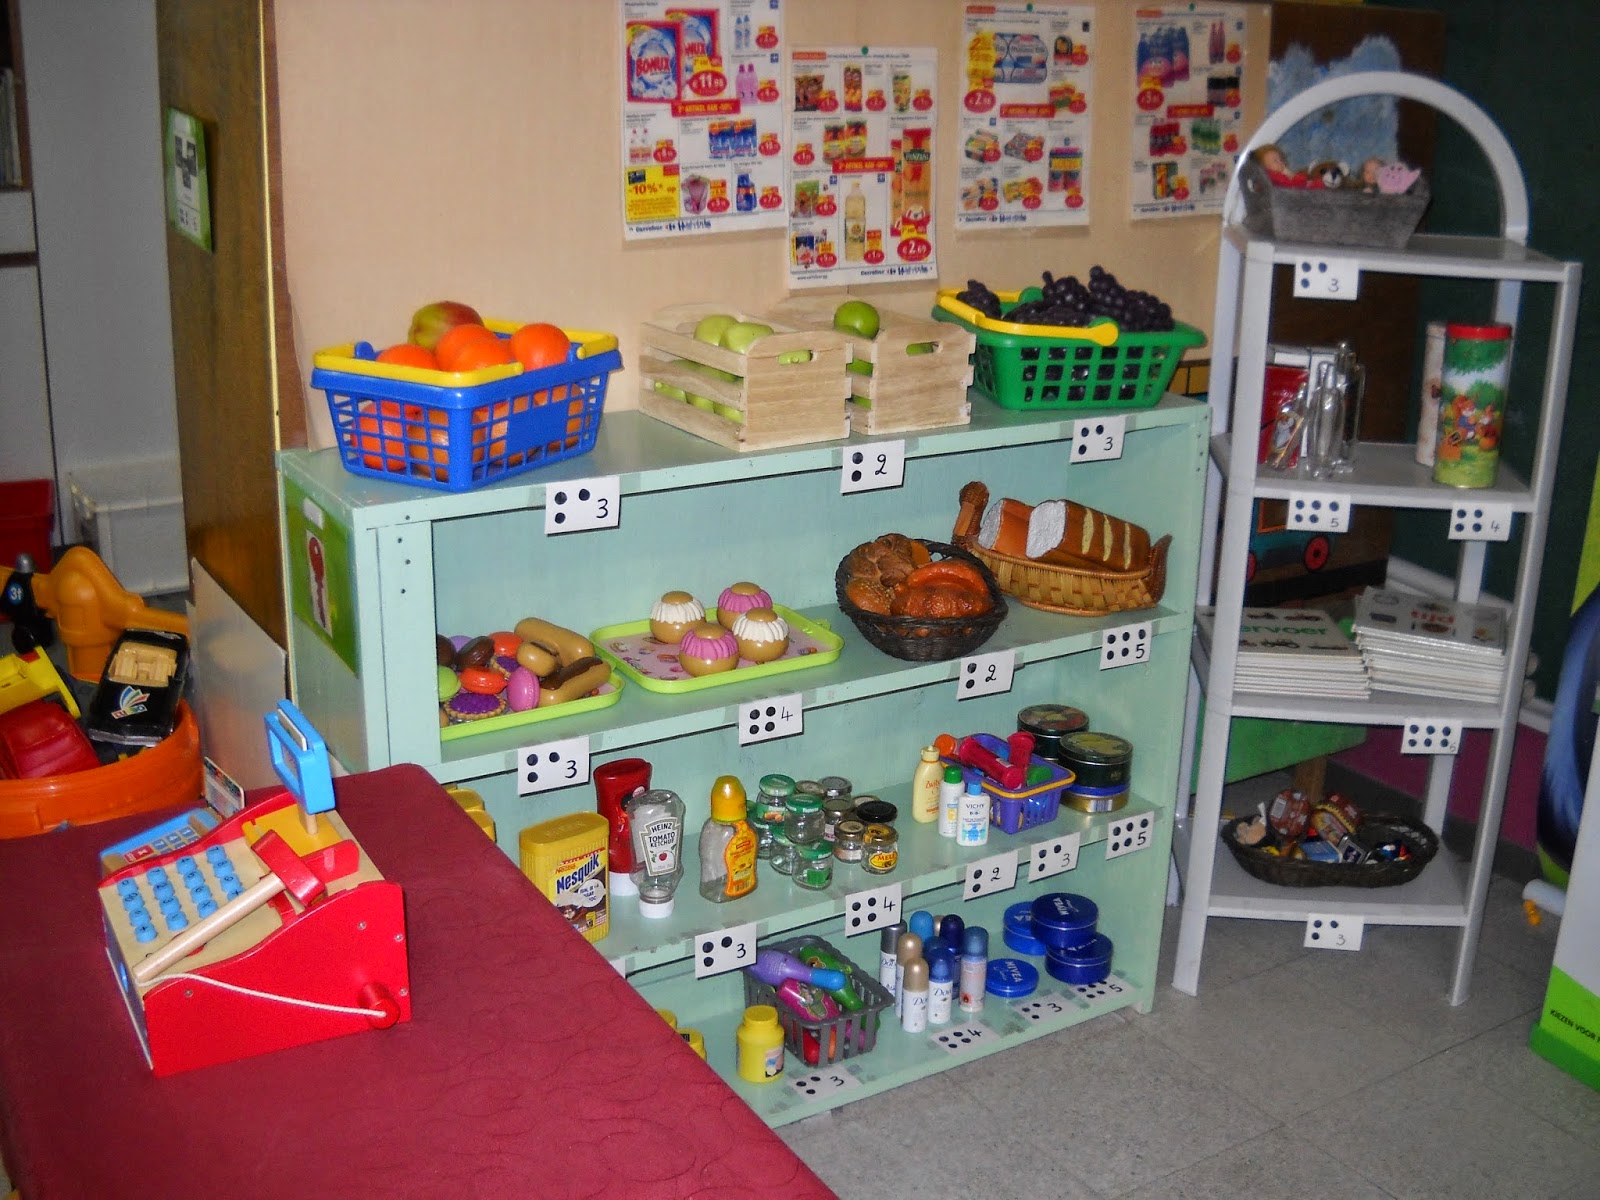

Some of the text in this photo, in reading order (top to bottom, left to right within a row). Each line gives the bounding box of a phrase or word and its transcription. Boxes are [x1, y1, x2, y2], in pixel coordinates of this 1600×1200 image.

[636, 56, 671, 76] BONUX
[1327, 278, 1340, 293] 3
[1103, 437, 1114, 452] 3
[874, 453, 888, 476] 2
[596, 498, 609, 519] 3
[1330, 517, 1340, 528] 5
[1490, 521, 1501, 532] 4
[1134, 643, 1146, 660] 5
[984, 664, 997, 683] 2
[781, 706, 794, 722] 4
[564, 760, 578, 779] 3
[651, 822, 673, 833] HEINZ
[649, 831, 676, 843] TOMATO
[650, 838, 675, 848] KETCHUP
[1136, 831, 1147, 846] 5
[1061, 853, 1071, 868] 3
[556, 853, 600, 895] Nesquik
[990, 867, 1002, 882] 2
[883, 896, 896, 913] 4
[1336, 934, 1347, 946] 3
[736, 943, 747, 959] 3
[1005, 961, 1023, 983] NIVEA
[1108, 983, 1123, 994] 5
[1047, 1002, 1063, 1013] 3
[1550, 1010, 1573, 1027] KIEZEN
[1576, 1024, 1595, 1040] VOOR
[967, 1028, 982, 1039] 4
[829, 1075, 845, 1087] 3
